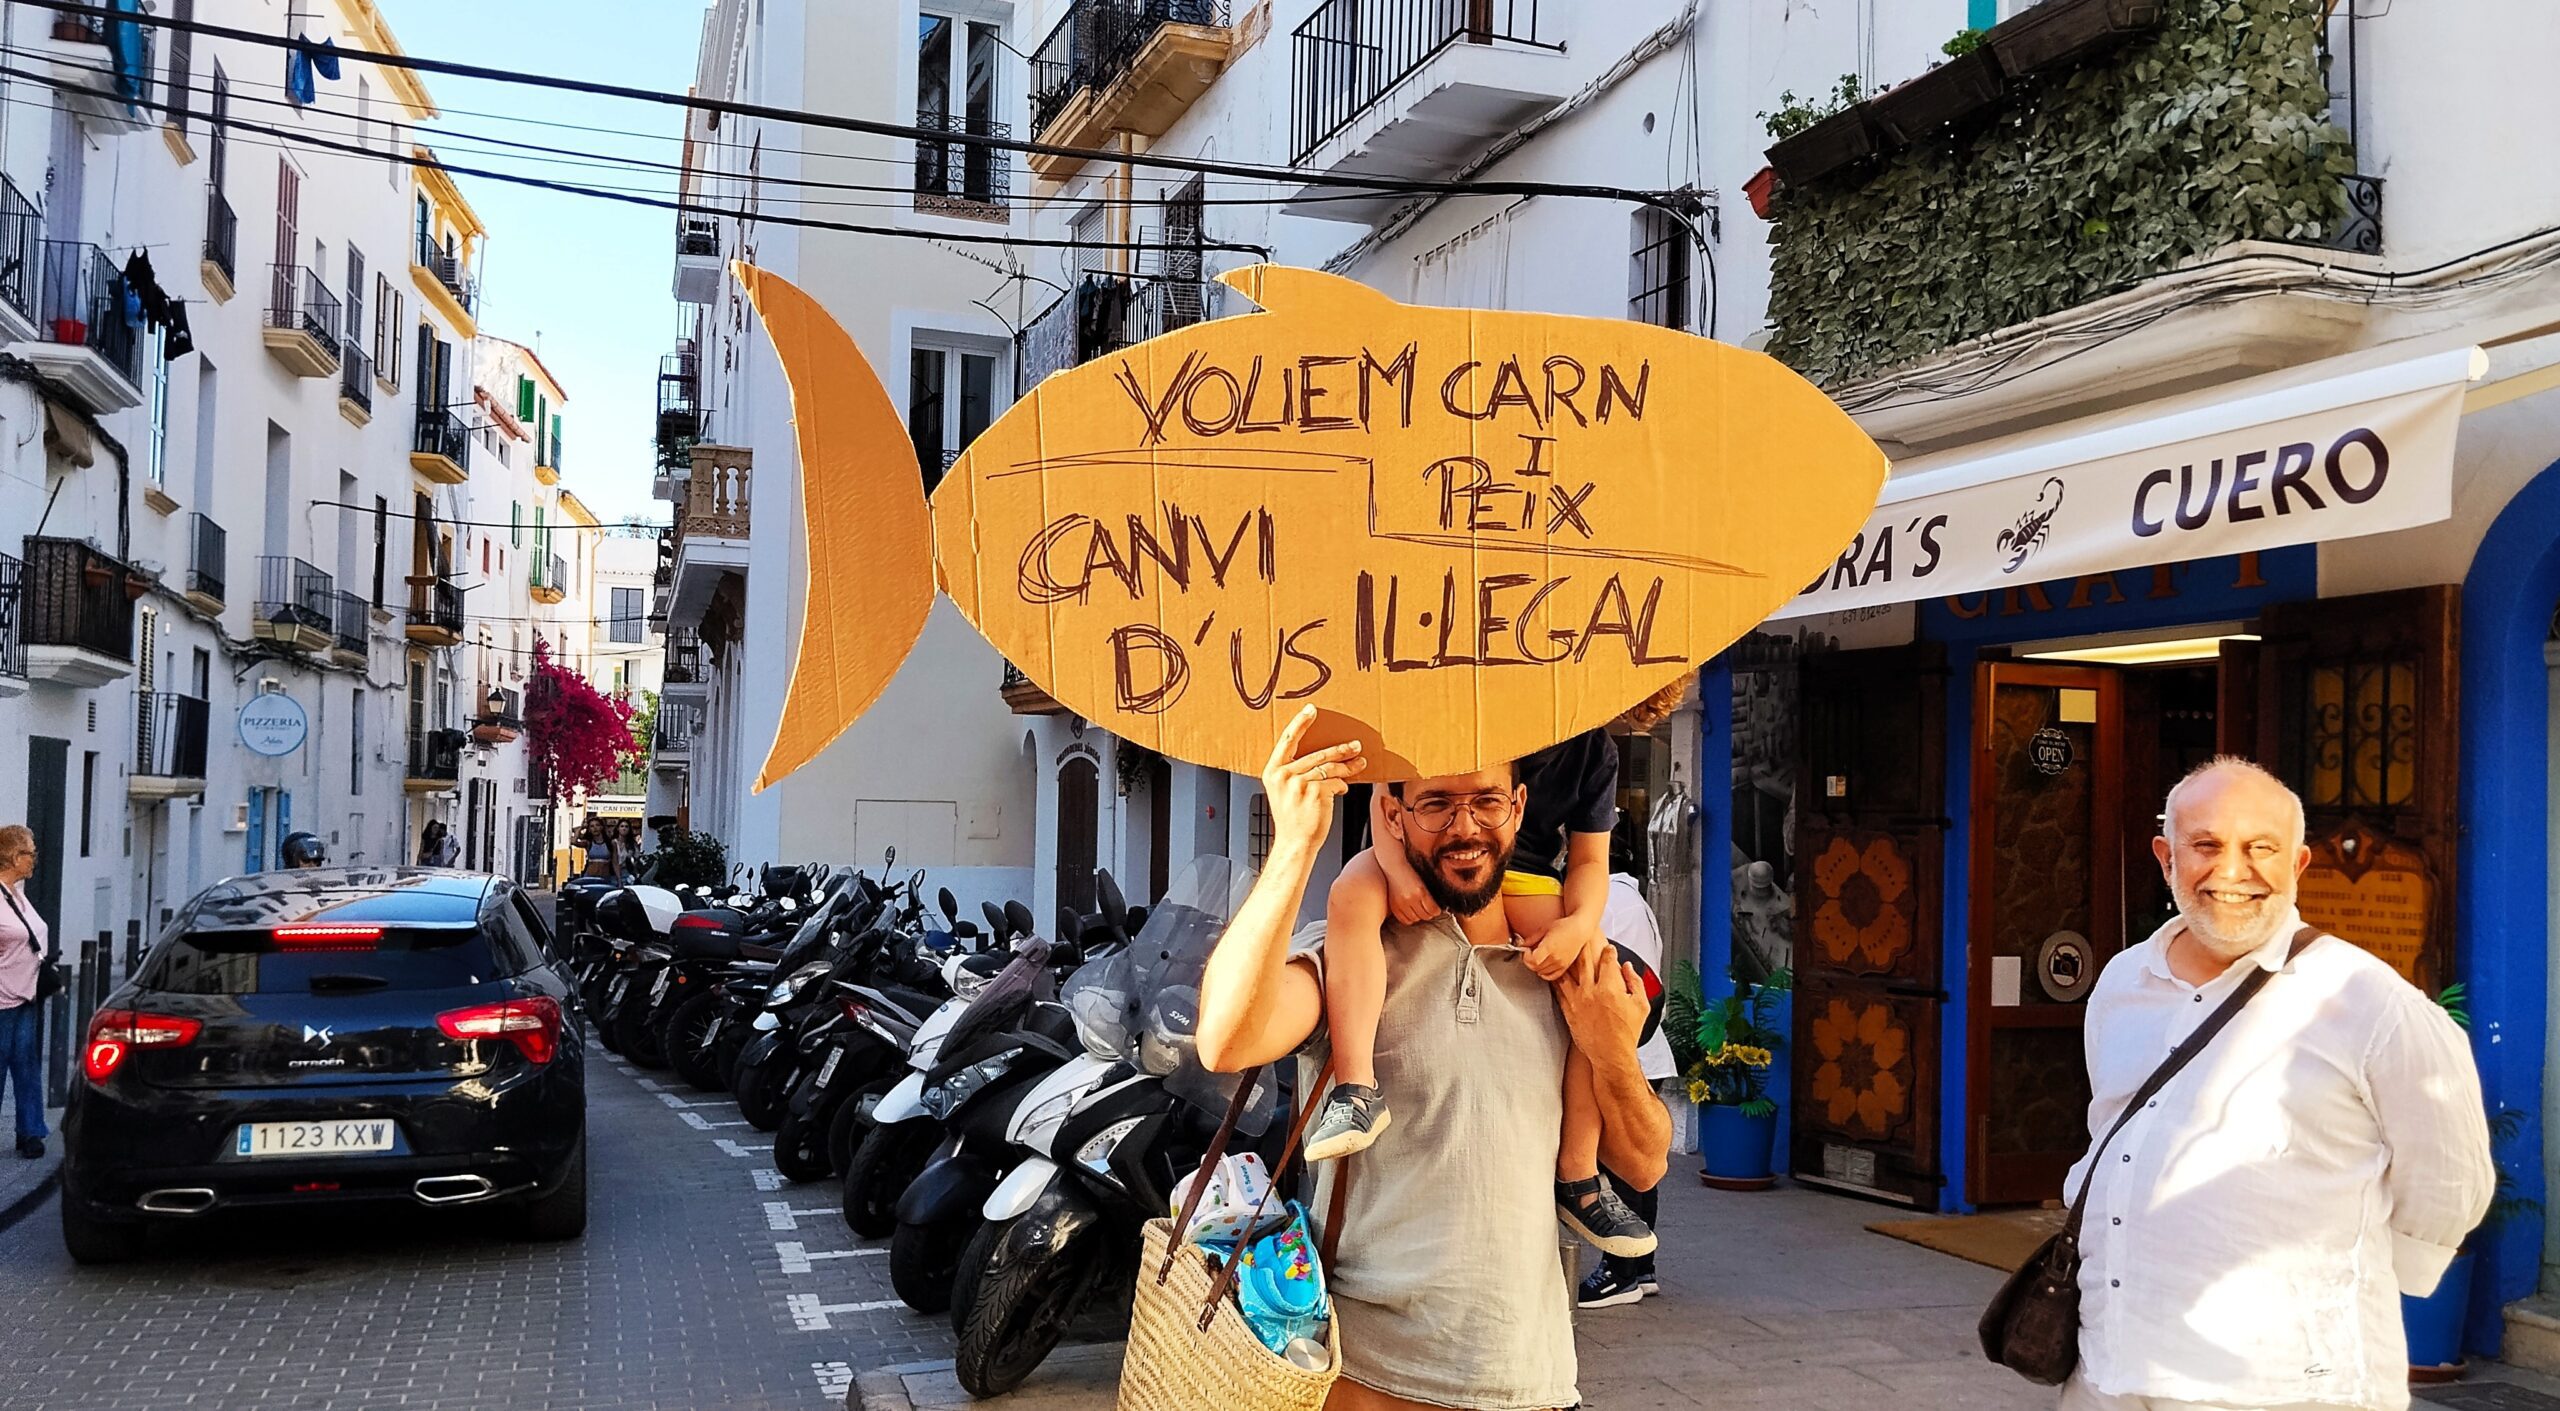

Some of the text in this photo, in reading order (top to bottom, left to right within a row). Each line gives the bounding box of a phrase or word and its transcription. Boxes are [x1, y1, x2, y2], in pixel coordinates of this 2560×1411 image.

[1114, 341, 1649, 447] VOLIEM CARN
[1515, 434, 1557, 477] I
[2133, 428, 2390, 538] CUERO
[1422, 456, 1596, 538] PEIX
[1018, 500, 1275, 606] CANVI
[1106, 611, 1332, 714] D'US
[244, 717, 301, 727] PIZZERIA
[2038, 746, 2065, 762] OPEN
[1169, 1010, 1190, 1026] SYM
[260, 1123, 385, 1149] 1123 KXW
